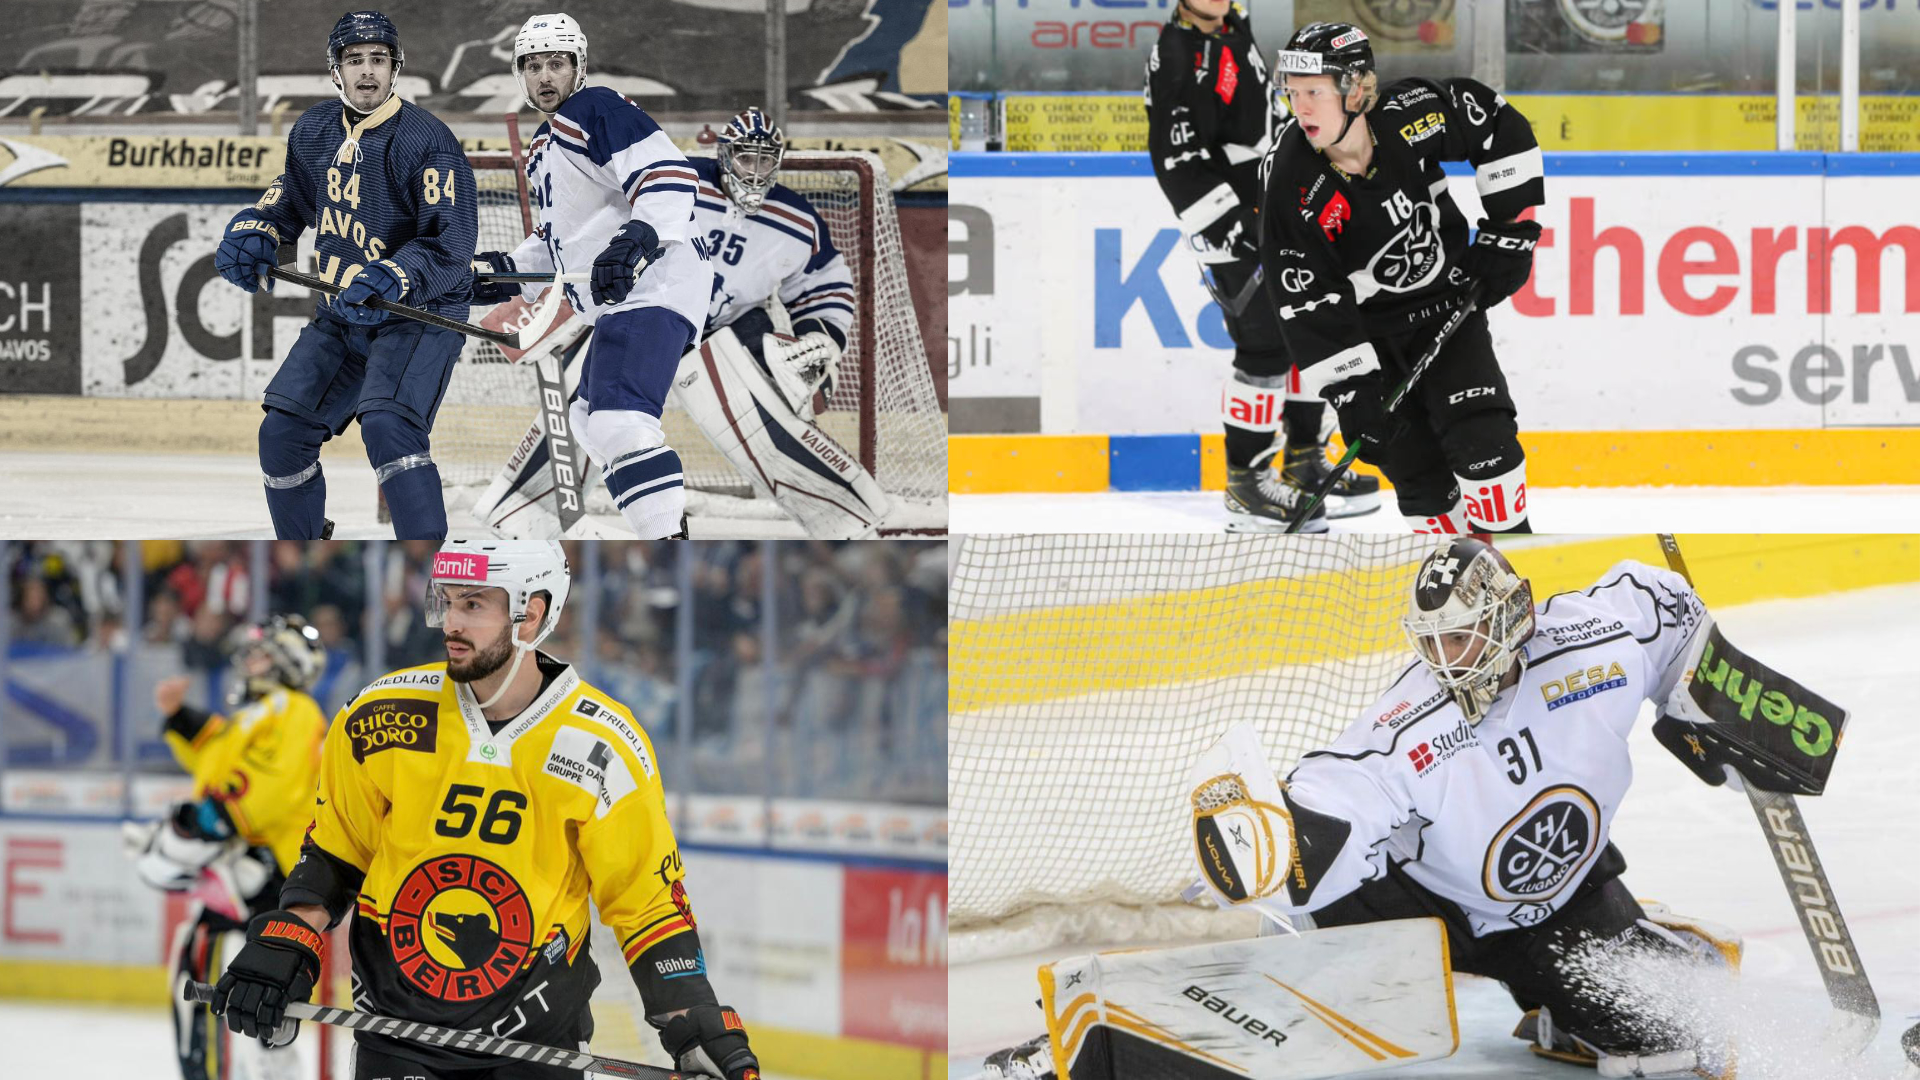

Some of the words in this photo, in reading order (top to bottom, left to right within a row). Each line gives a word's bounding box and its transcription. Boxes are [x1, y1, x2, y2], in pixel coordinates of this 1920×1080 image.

[532, 21, 549, 29] 56
[107, 138, 271, 169] Burkhalter
[327, 166, 361, 210] 84
[423, 167, 456, 206] 84
[1487, 167, 1517, 181] 1941-2021
[1380, 187, 1414, 227] 18
[707, 228, 748, 267] 35
[1476, 231, 1537, 252] CCM
[1280, 267, 1316, 293] GP
[1229, 393, 1275, 425] ail
[1448, 386, 1497, 405] CCM
[506, 423, 542, 474] VAUGHN
[799, 428, 853, 474] VAUGHN
[1546, 616, 1602, 636] Gruppo
[1552, 620, 1625, 647] Sicurezza
[1540, 661, 1627, 703] DESA
[1548, 677, 1628, 711] AUTOGLASS
[508, 676, 575, 740] LINDENHOFGRUPPE
[1694, 640, 1834, 758] Gehri
[351, 711, 428, 739] CHICCO
[550, 753, 585, 773] MARCO
[1418, 761, 1442, 779] VISUAL
[1497, 726, 1544, 787] 31
[546, 763, 583, 784] GRUPPE
[434, 783, 528, 846] 56
[1517, 863, 1570, 893] LUGANO
